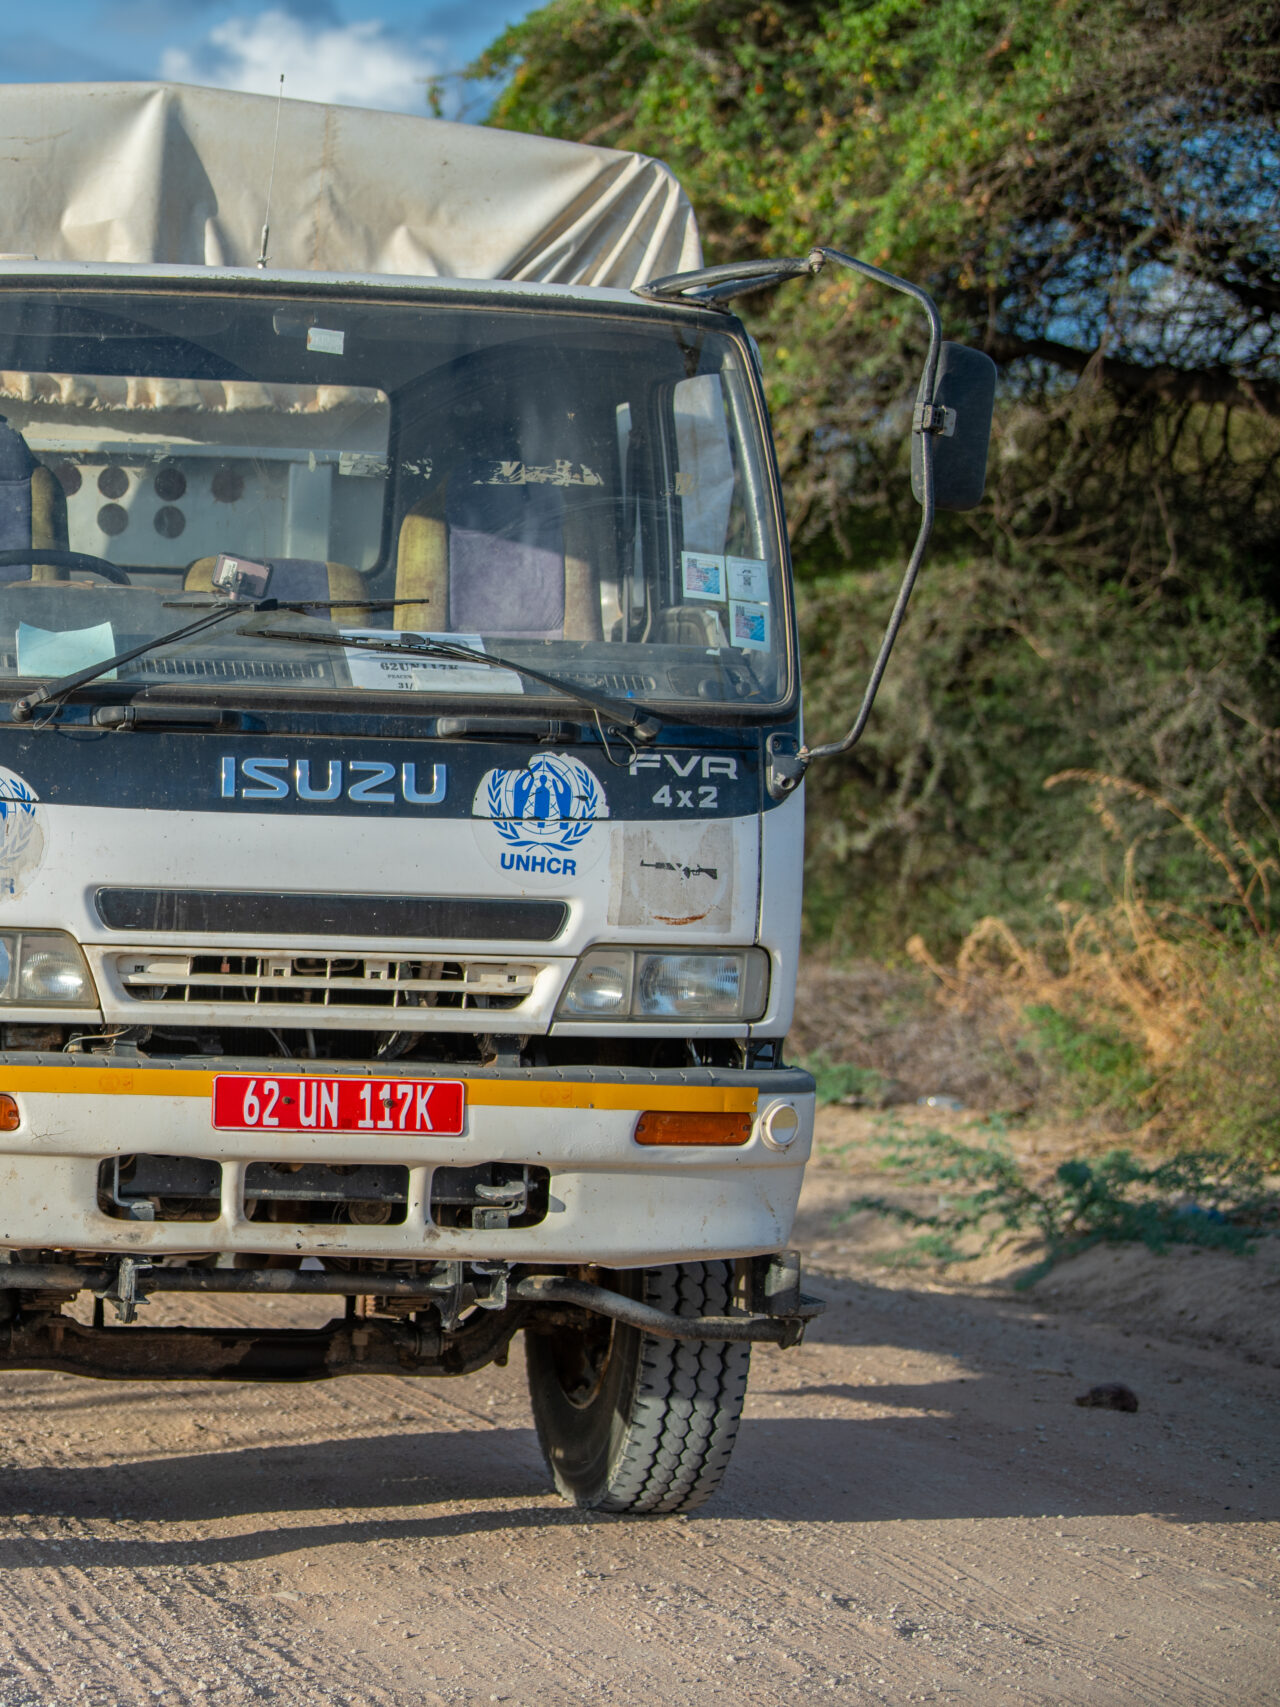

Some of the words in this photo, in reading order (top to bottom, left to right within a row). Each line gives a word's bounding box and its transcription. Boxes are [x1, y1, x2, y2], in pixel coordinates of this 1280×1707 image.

[221, 756, 447, 804] ISUZU
[628, 753, 739, 780] FVR
[652, 784, 719, 809] 4x2
[500, 852, 577, 876] UNHCR
[242, 1080, 280, 1127] 62
[298, 1081, 339, 1128] UN
[356, 1083, 435, 1131] 117K
